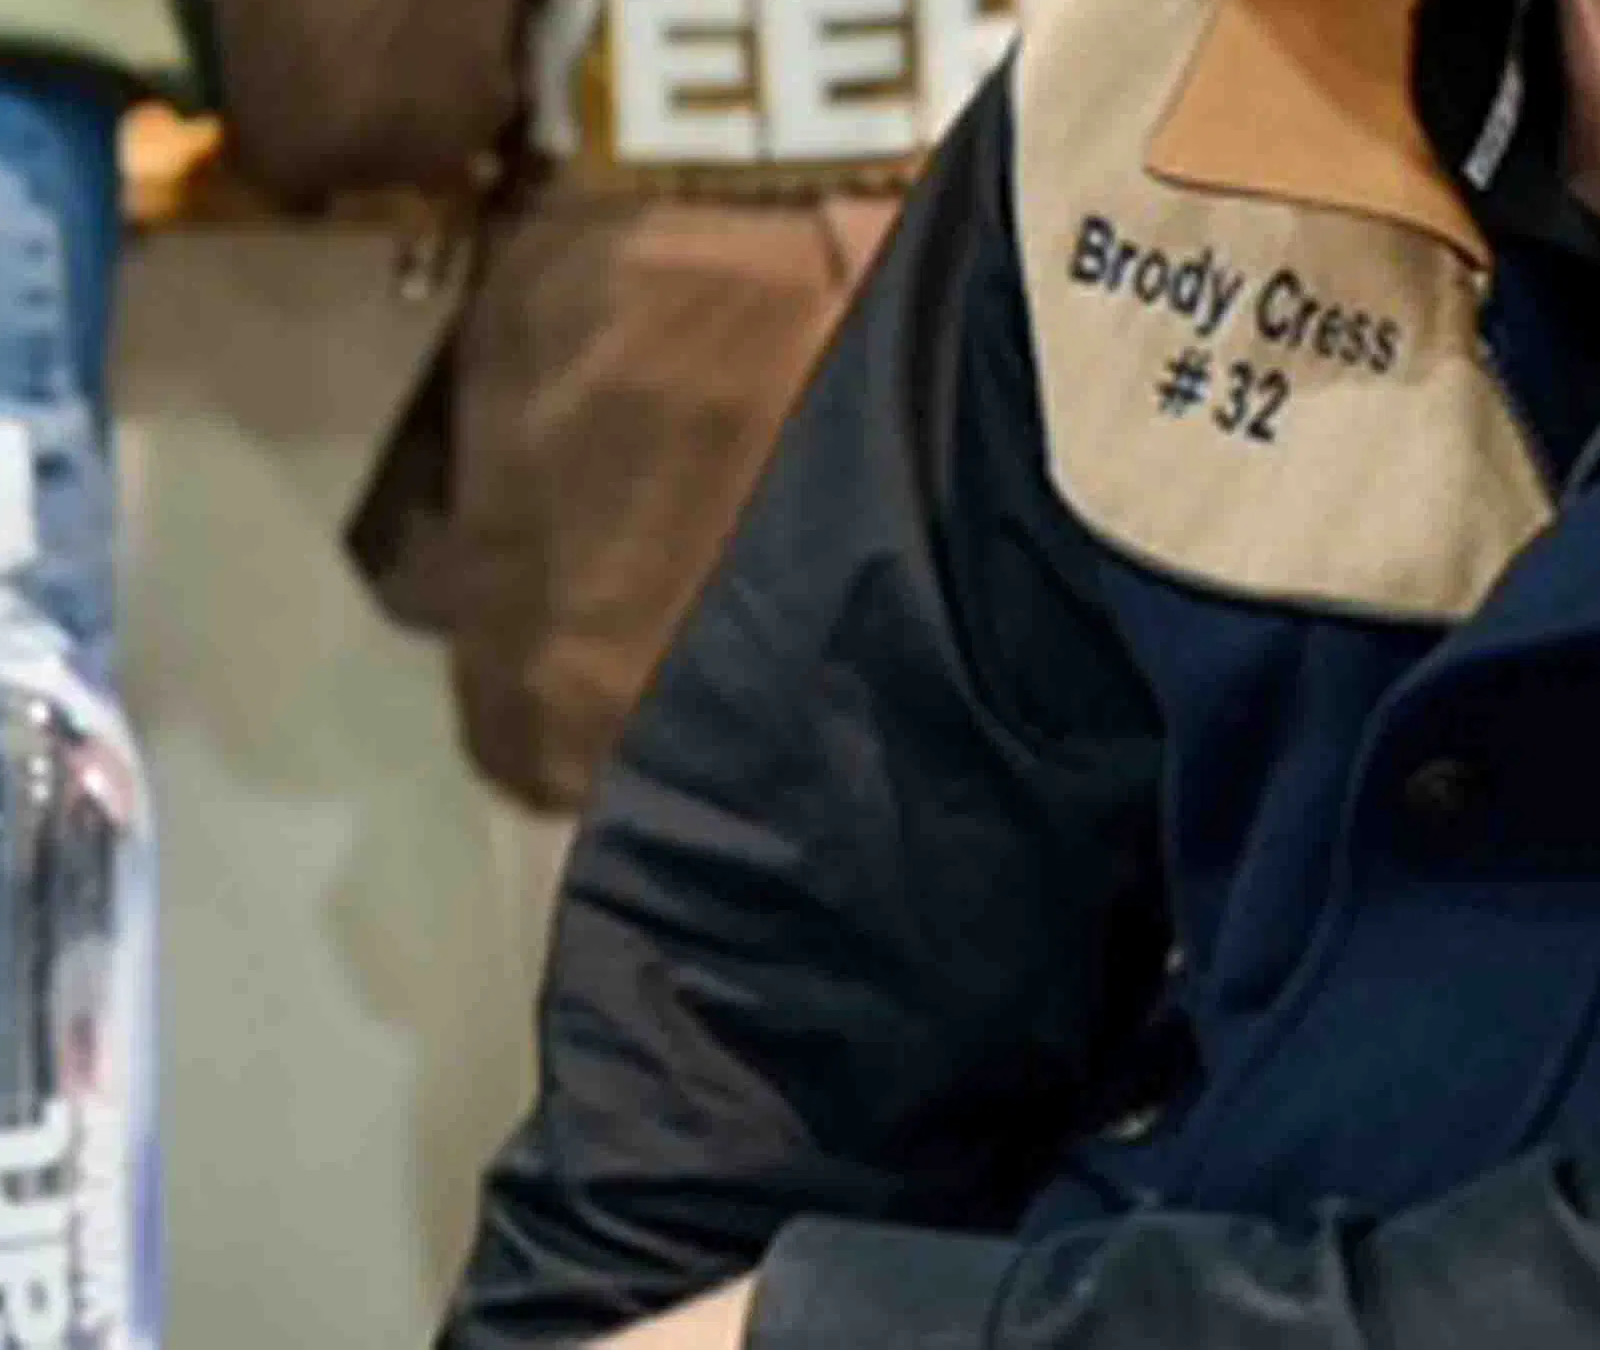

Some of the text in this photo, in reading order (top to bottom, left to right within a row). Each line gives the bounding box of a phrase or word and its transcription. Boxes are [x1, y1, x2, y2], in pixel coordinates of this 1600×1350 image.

[1069, 214, 1401, 374] Brody Cress
[1155, 347, 1291, 443] #32
